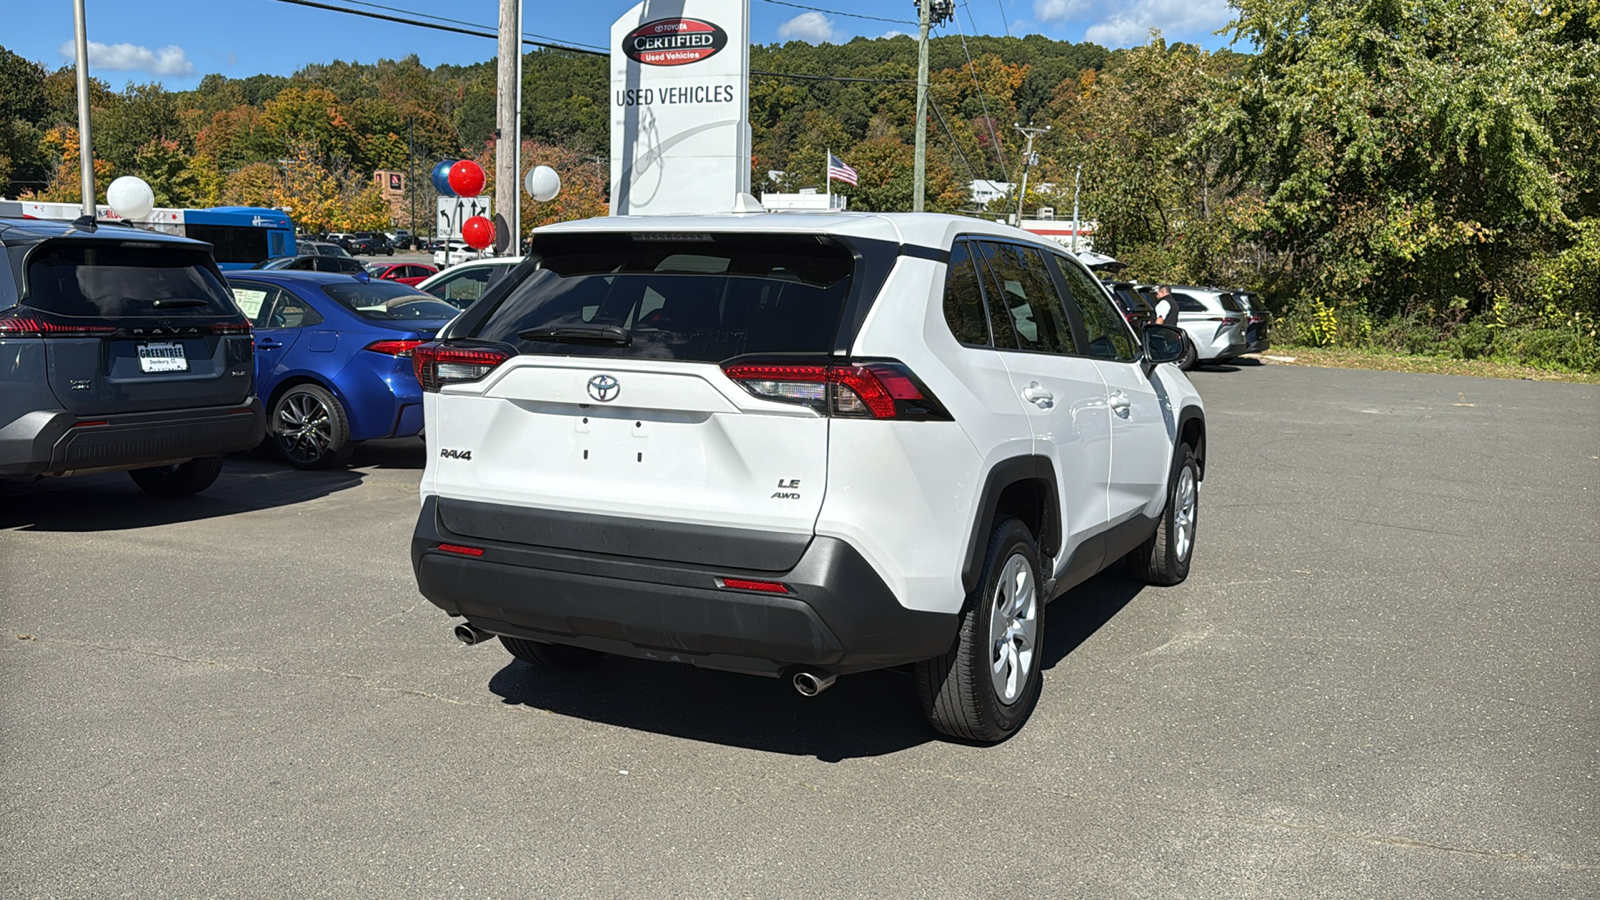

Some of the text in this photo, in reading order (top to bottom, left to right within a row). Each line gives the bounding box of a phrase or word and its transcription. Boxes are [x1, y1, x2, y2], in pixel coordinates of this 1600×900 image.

[664, 23, 688, 31] TOYOTA
[634, 34, 714, 50] CERTIFIED
[645, 51, 700, 61] Used Vehicles
[616, 85, 734, 107] USED VEHICLES
[139, 347, 183, 358] GREENTREE
[440, 448, 472, 461] RAV4
[777, 478, 801, 489] LE
[770, 491, 801, 500] AWD
